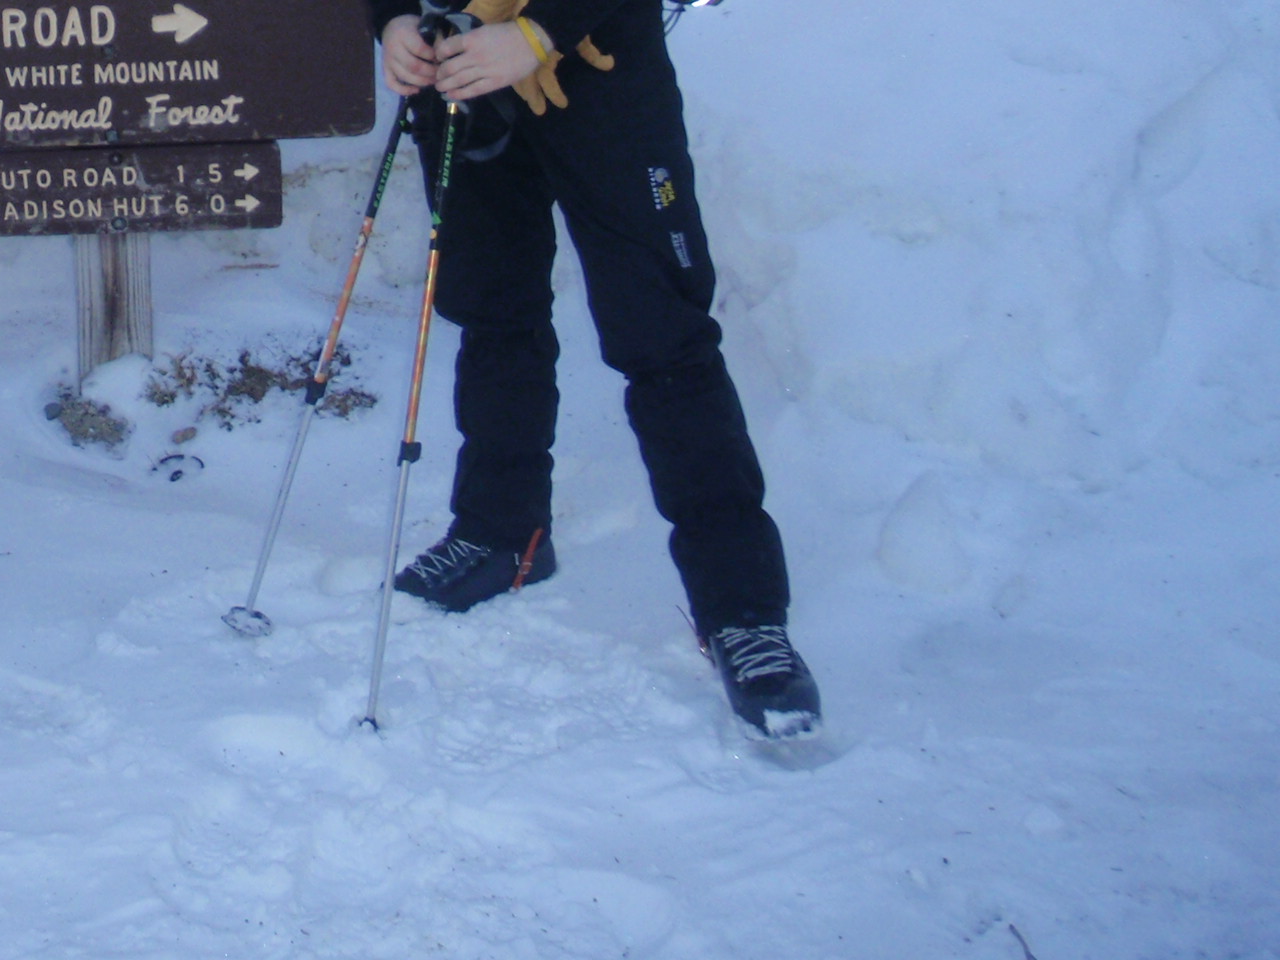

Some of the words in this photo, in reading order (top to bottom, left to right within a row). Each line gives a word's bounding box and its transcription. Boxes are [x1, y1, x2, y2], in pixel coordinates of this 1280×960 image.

[1, 4, 116, 48] ROAD
[5, 63, 83, 87] WHITE
[93, 59, 220, 85] MOUNTAIN
[145, 93, 244, 127] Forest
[63, 166, 138, 188] ROAD
[112, 195, 165, 217] HUT
